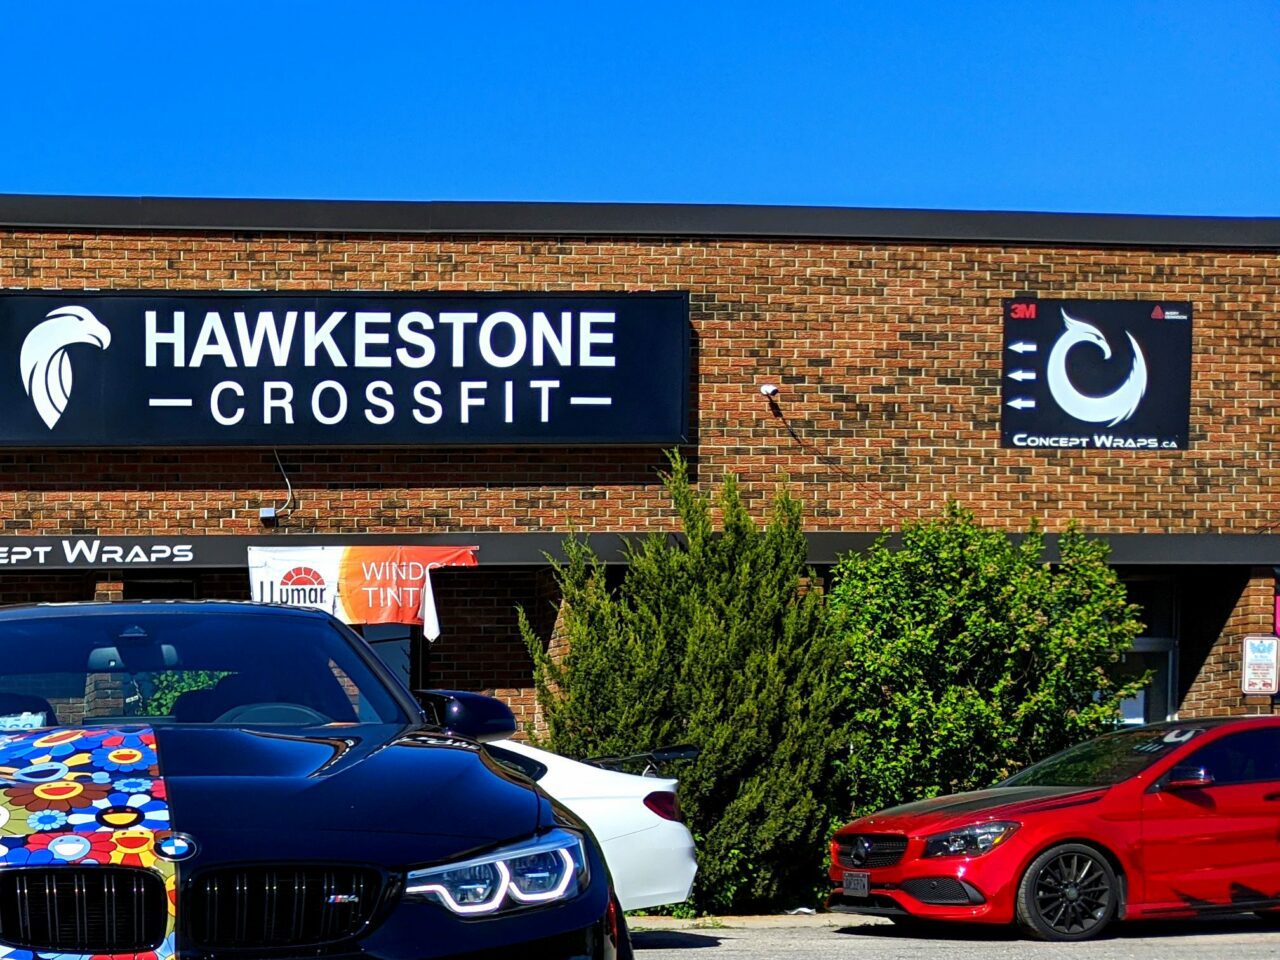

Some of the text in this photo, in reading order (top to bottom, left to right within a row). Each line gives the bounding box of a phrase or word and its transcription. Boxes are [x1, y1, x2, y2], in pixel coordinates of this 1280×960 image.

[1011, 303, 1037, 319] 3M
[145, 311, 616, 369] HAWKESTONE
[210, 380, 560, 426] CROSSFIT
